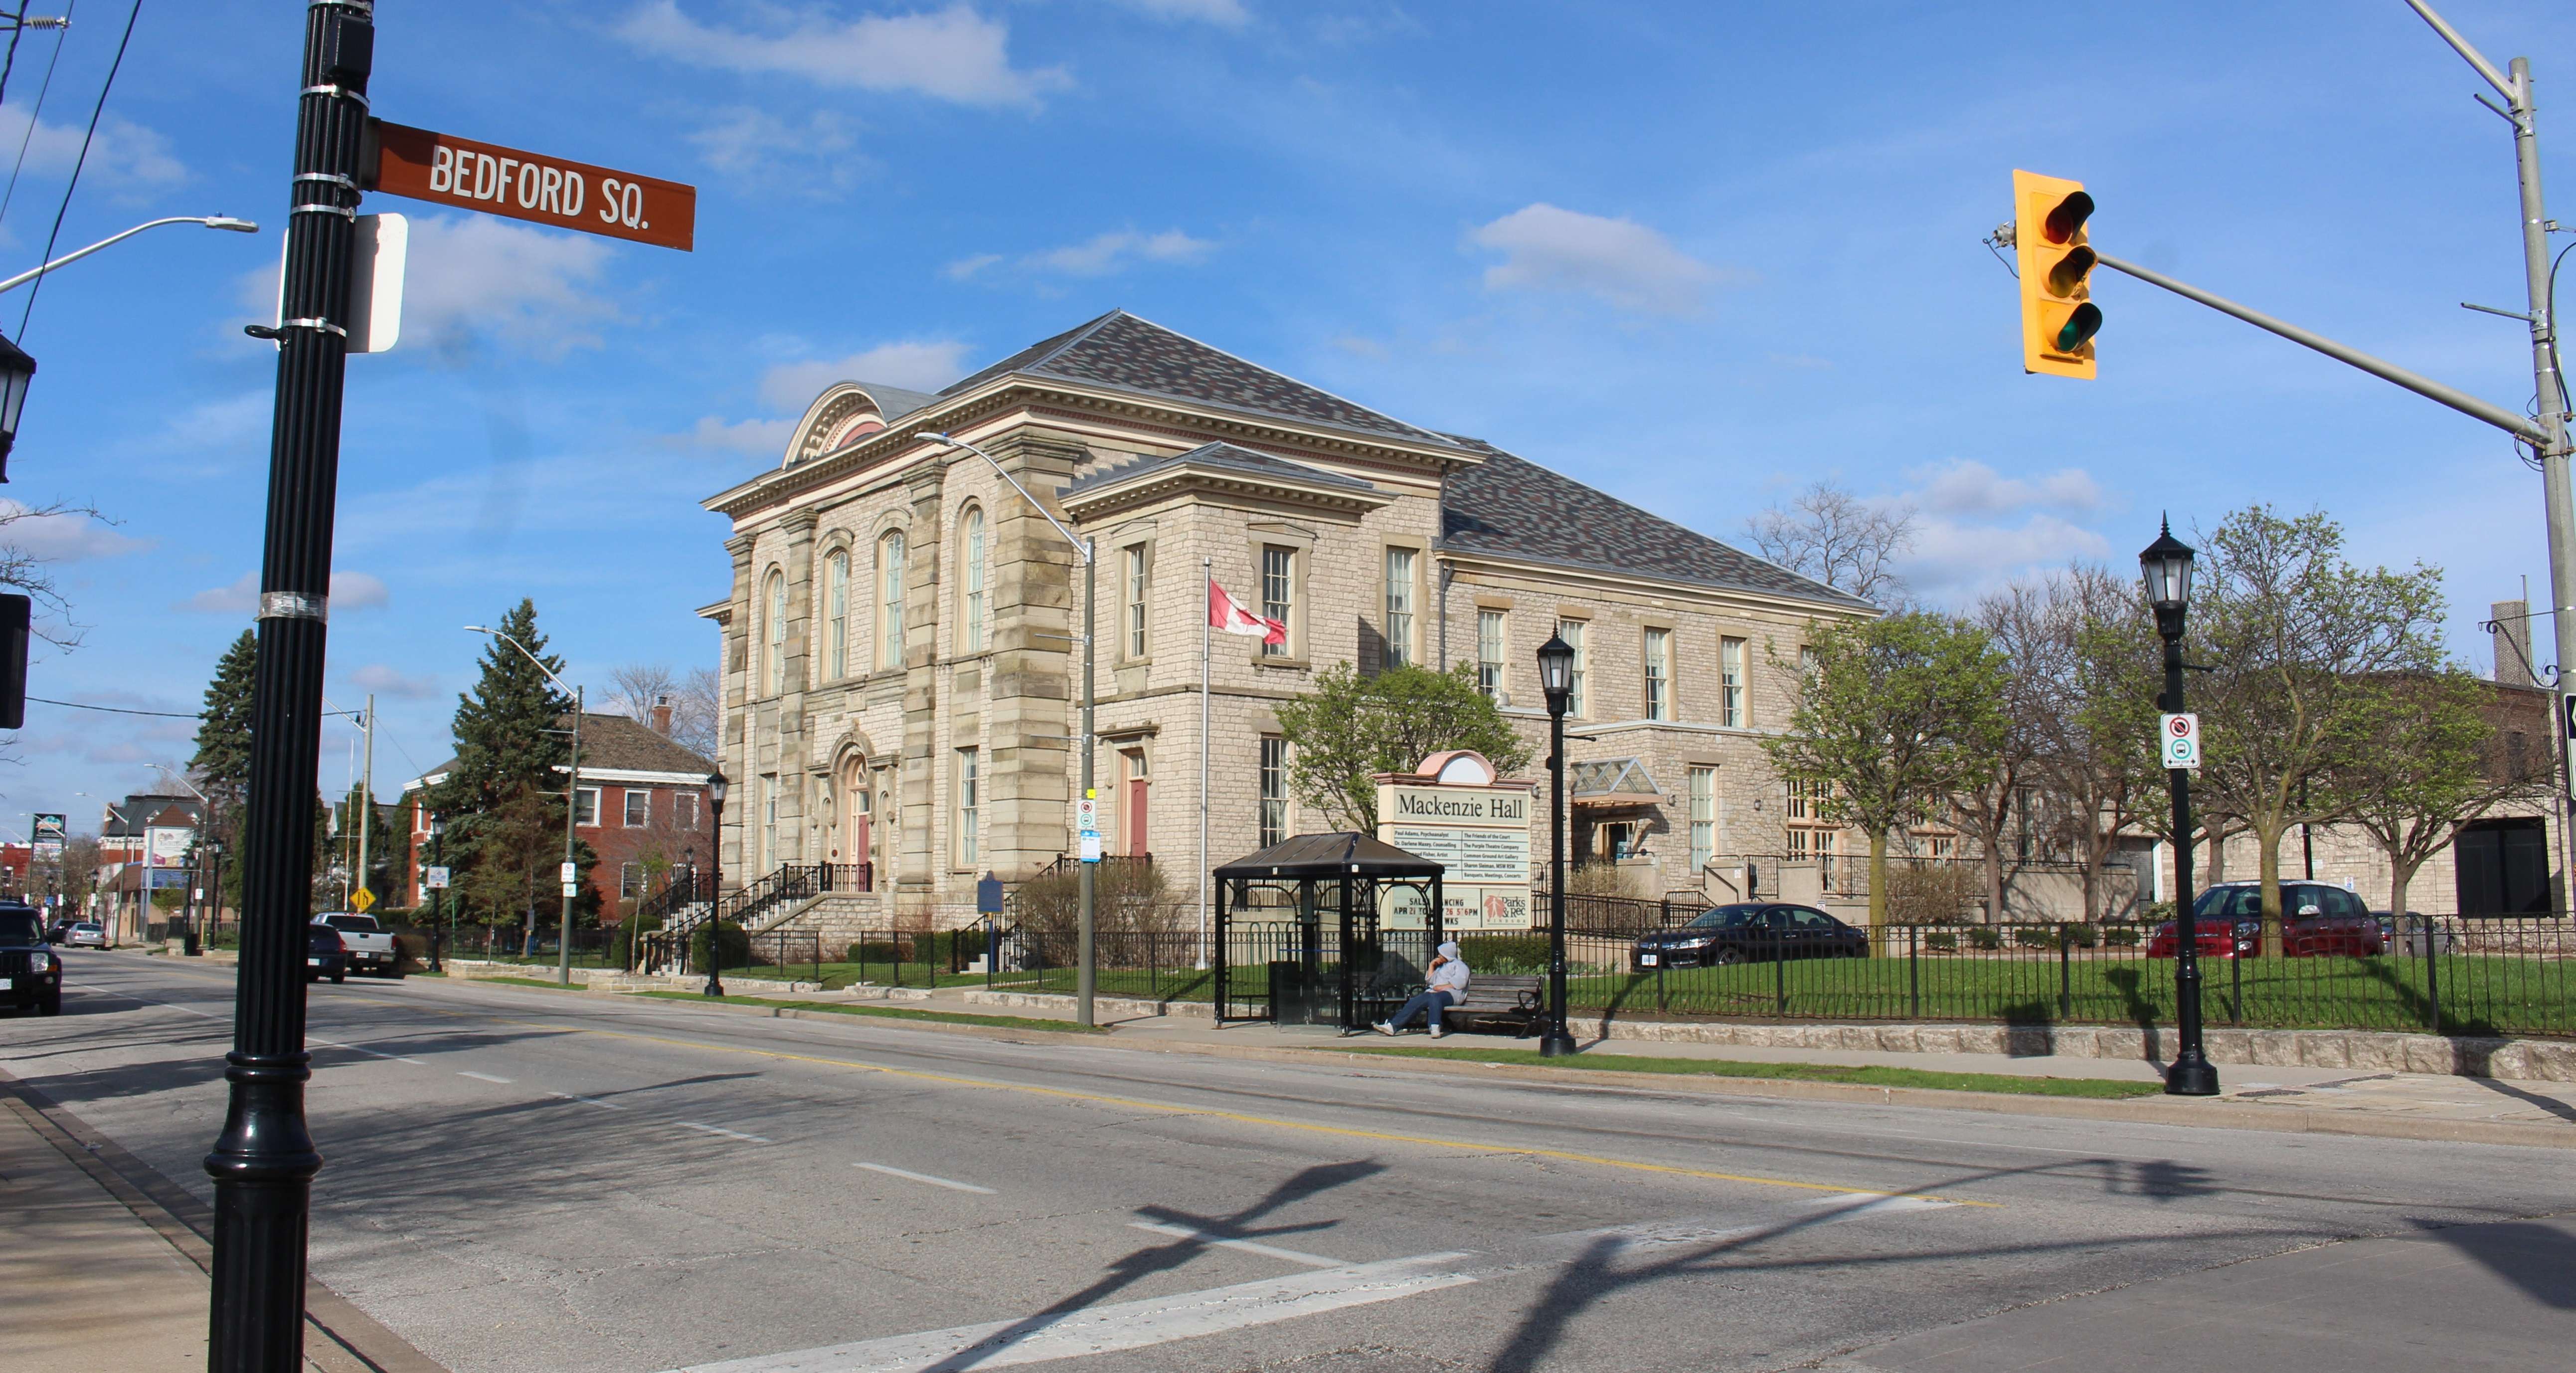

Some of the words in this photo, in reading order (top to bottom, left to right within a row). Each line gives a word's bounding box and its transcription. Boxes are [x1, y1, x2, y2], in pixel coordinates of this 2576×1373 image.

[429, 145, 584, 216] BEDFORD
[599, 178, 649, 230] SQ.
[1399, 794, 1483, 817] Mackenzie
[1490, 798, 1523, 818] Hall
[1502, 896, 1526, 907] Parks
[1503, 907, 1509, 918] &
[1511, 907, 1526, 918] Rec
